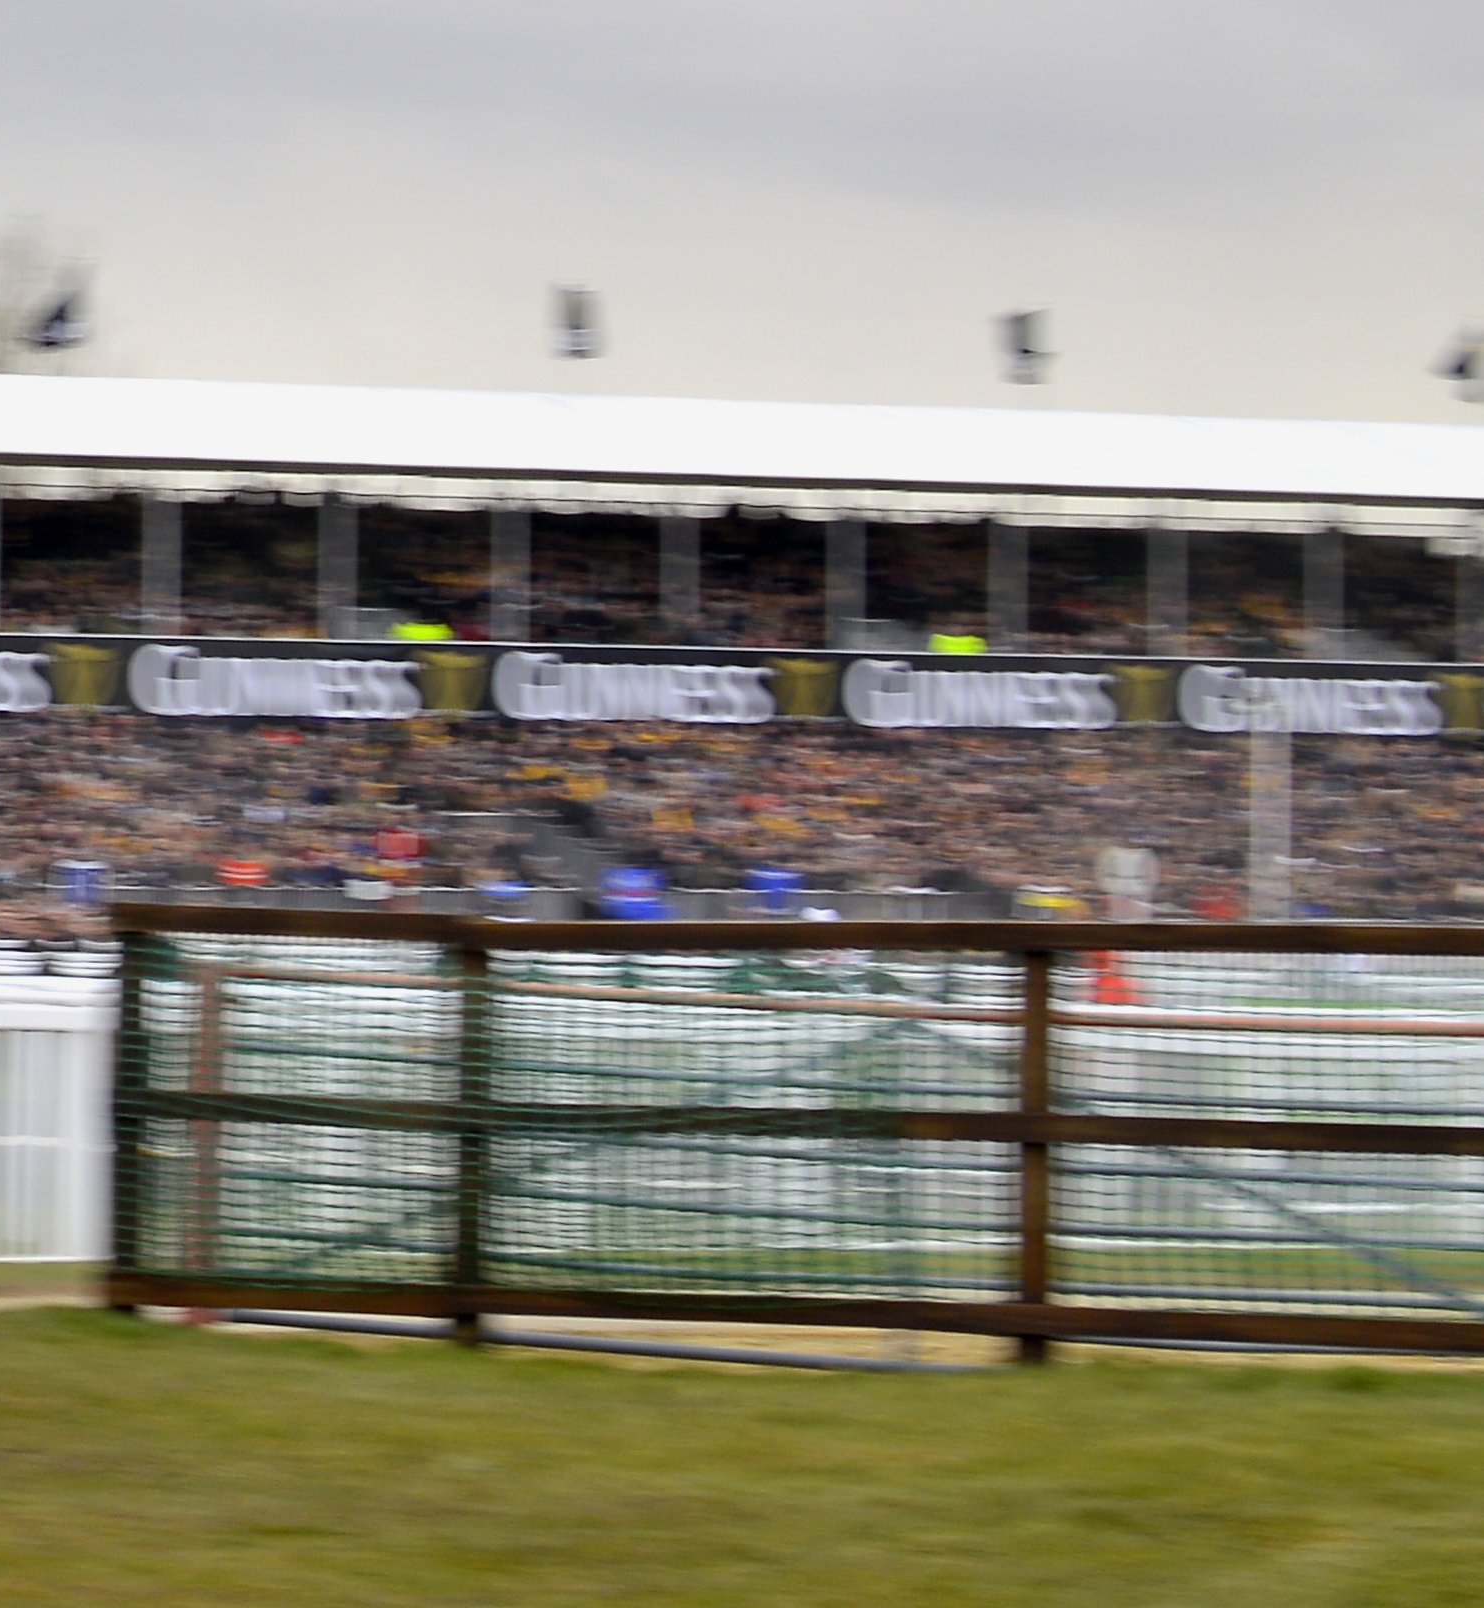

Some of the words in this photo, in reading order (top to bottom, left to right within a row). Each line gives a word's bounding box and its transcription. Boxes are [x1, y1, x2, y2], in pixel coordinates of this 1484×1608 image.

[128, 643, 422, 719] GUINNESS
[492, 651, 776, 724] GUINNESS
[842, 659, 1118, 730] GUINNESS
